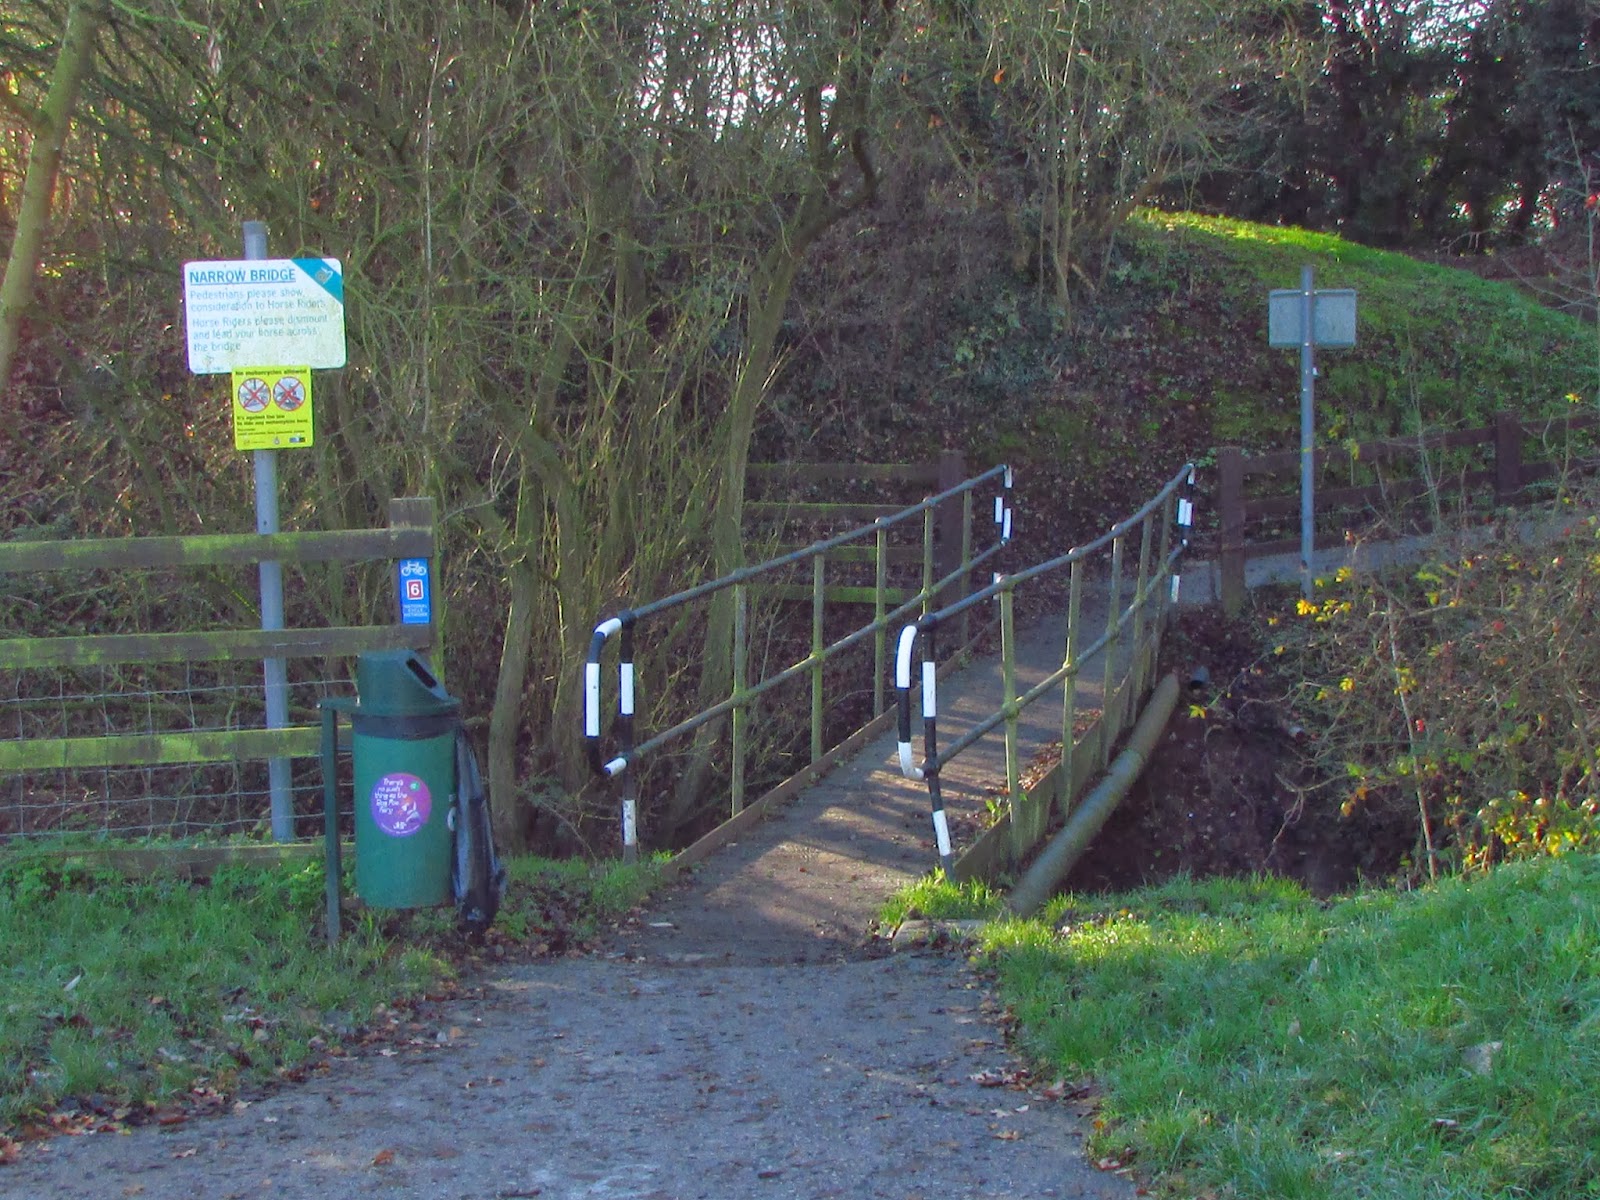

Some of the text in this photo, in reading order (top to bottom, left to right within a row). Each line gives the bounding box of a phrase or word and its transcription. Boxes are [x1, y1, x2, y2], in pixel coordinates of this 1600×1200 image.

[190, 268, 296, 283] NARROW BRIDGE
[190, 288, 303, 301] Pedestrians please show
[191, 301, 253, 312] consideration
[256, 300, 265, 310] to
[268, 299, 294, 310] Horse
[192, 314, 328, 328] Horse Riders please dismount
[193, 330, 209, 340] and
[213, 328, 232, 339] lead
[235, 329, 254, 340] your
[258, 327, 283, 337] horse
[194, 341, 241, 353] the bridge
[411, 583, 420, 596] 6
